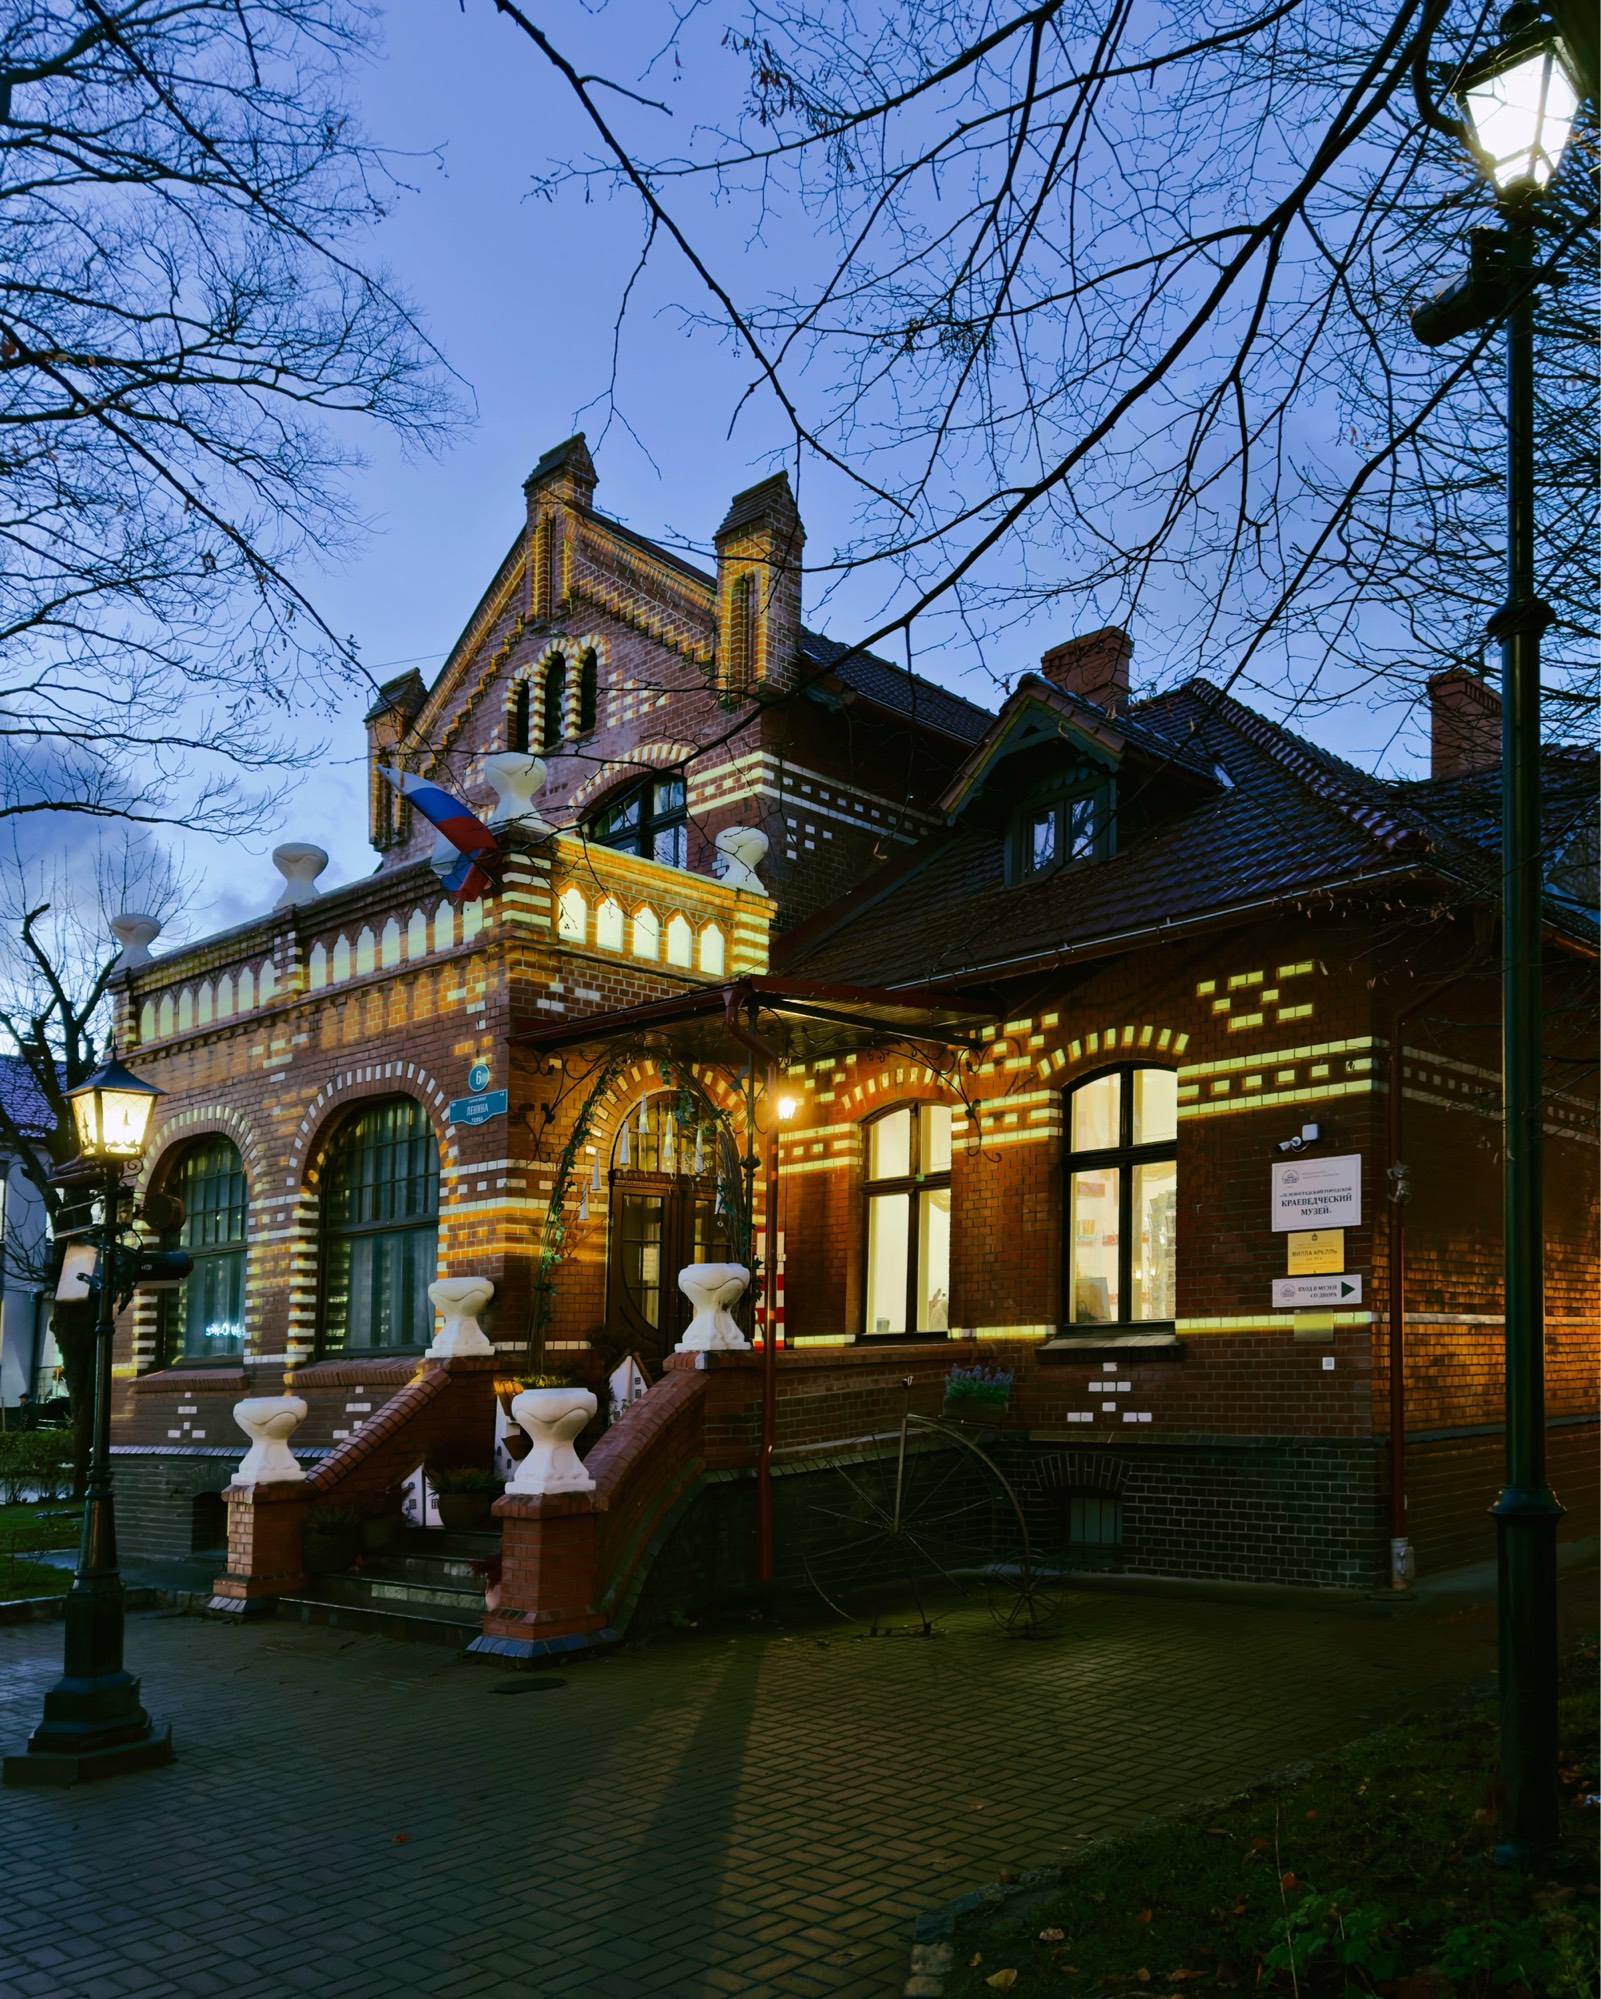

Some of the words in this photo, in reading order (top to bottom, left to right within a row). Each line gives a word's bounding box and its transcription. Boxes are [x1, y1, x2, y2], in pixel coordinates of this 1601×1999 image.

[475, 1070, 482, 1085] 6
[466, 1103, 489, 1116] ЛЕНИНА
[1281, 1193, 1352, 1207] КРАЕВЕДЧЕСКИЙ
